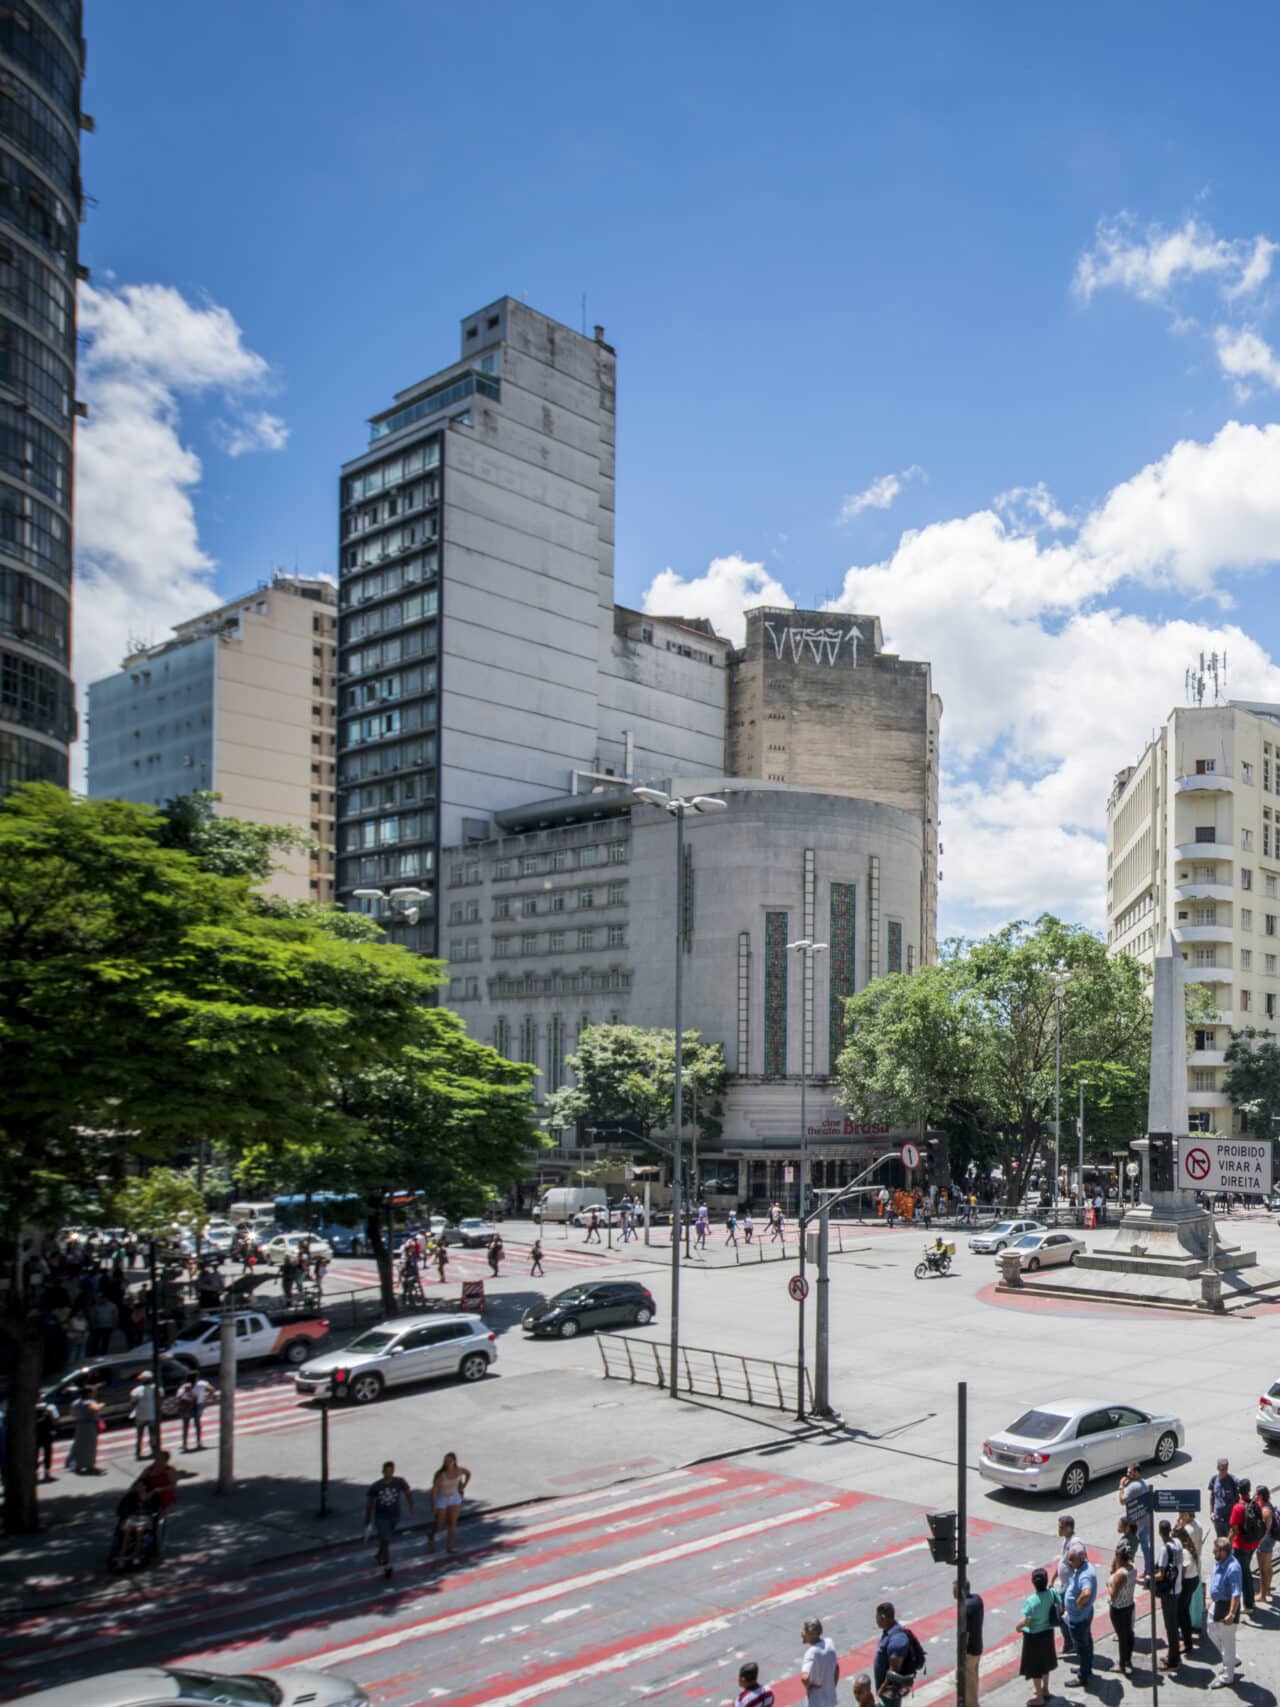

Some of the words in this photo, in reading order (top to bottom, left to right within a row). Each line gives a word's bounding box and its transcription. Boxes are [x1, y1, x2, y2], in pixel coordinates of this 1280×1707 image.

[1217, 1145, 1265, 1158] PROIBIDO
[1218, 1160, 1250, 1172] VIRAR
[1255, 1158, 1262, 1173] À
[1221, 1175, 1260, 1188] DIREITA
